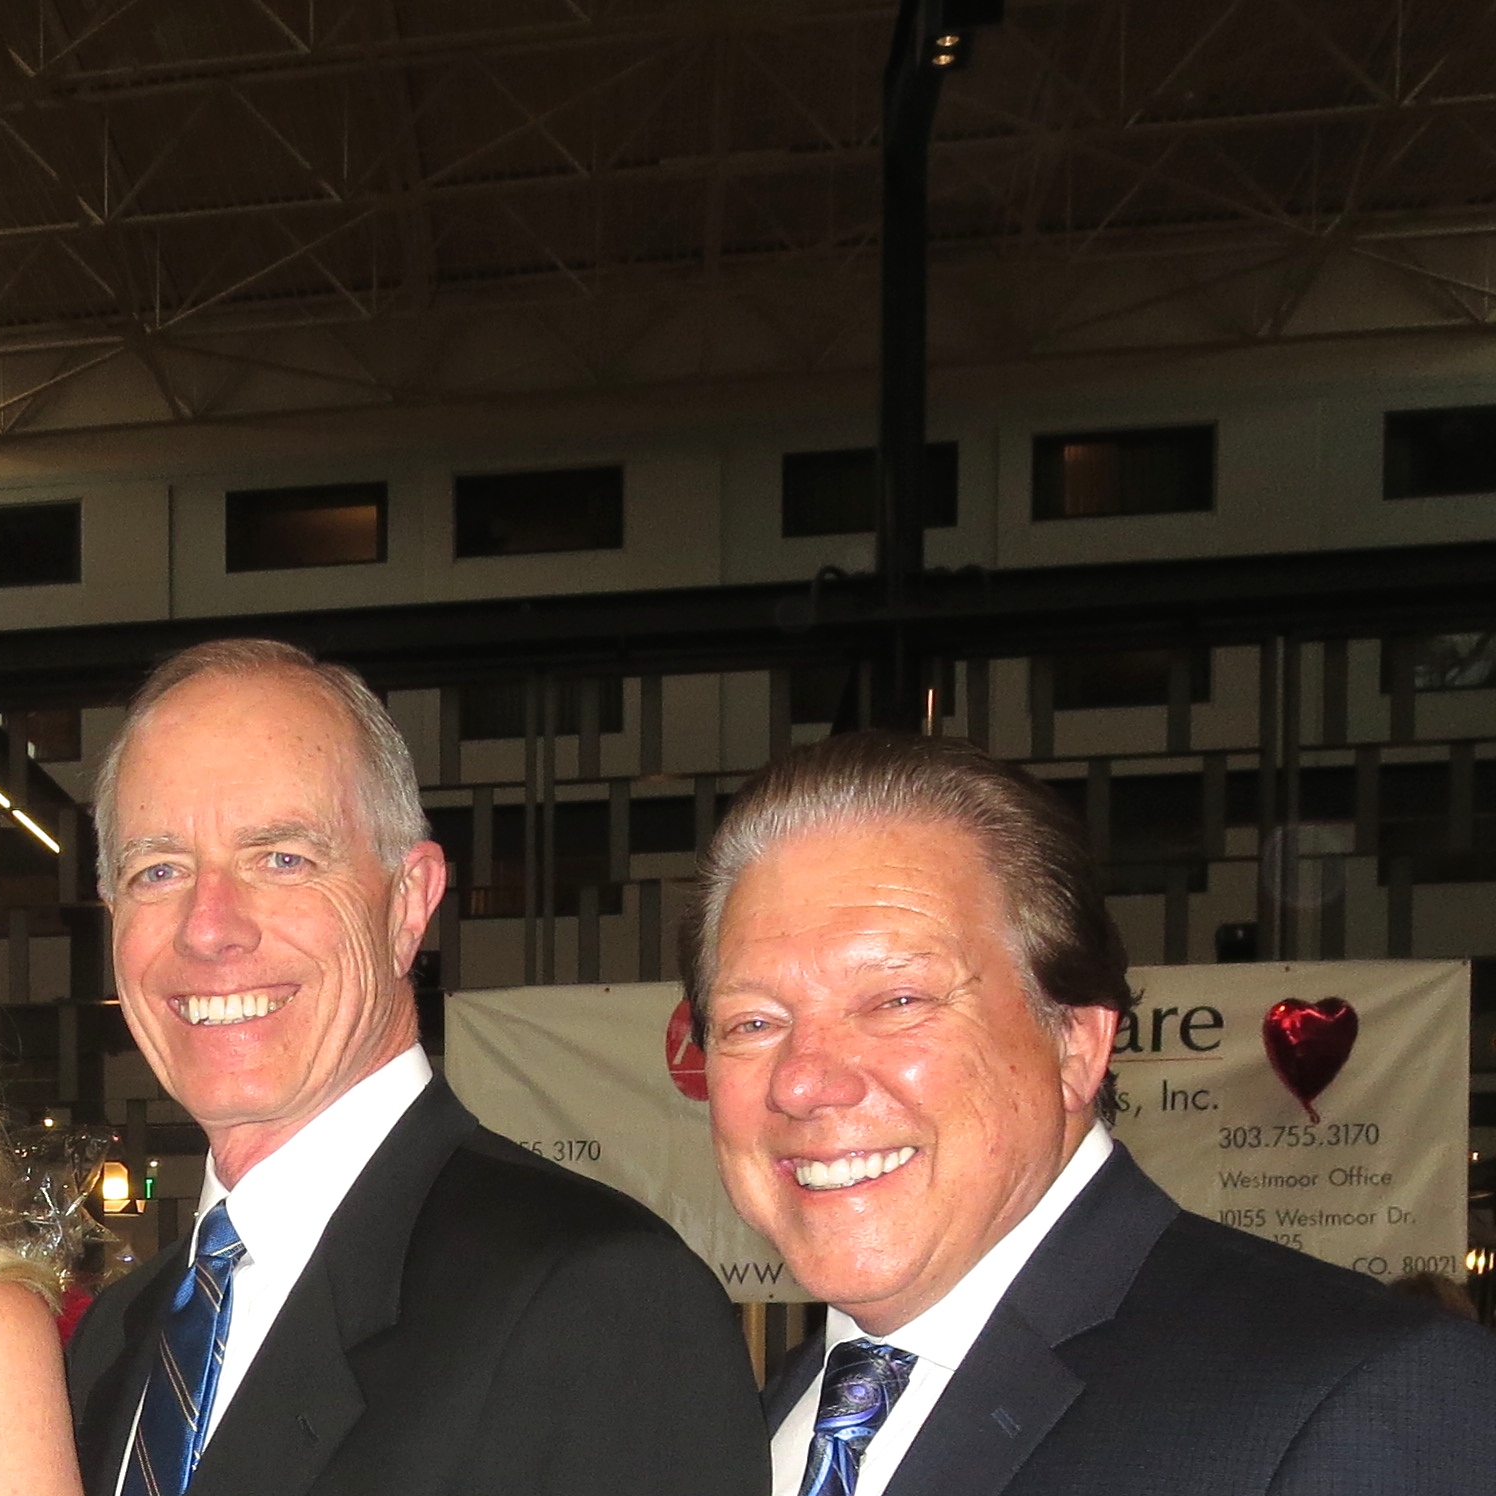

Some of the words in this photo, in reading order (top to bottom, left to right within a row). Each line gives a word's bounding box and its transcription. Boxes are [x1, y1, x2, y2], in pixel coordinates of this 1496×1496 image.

[1112, 1005, 1224, 1054] are
[1162, 1079, 1219, 1111] Inc.
[1218, 1123, 1380, 1150] 303.755.3170
[1218, 1170, 1319, 1190] Westmoor
[1329, 1167, 1393, 1188] Office
[1218, 1209, 1267, 1228] 10155
[1275, 1208, 1377, 1228] Westmoor
[1387, 1206, 1416, 1226] Dr.
